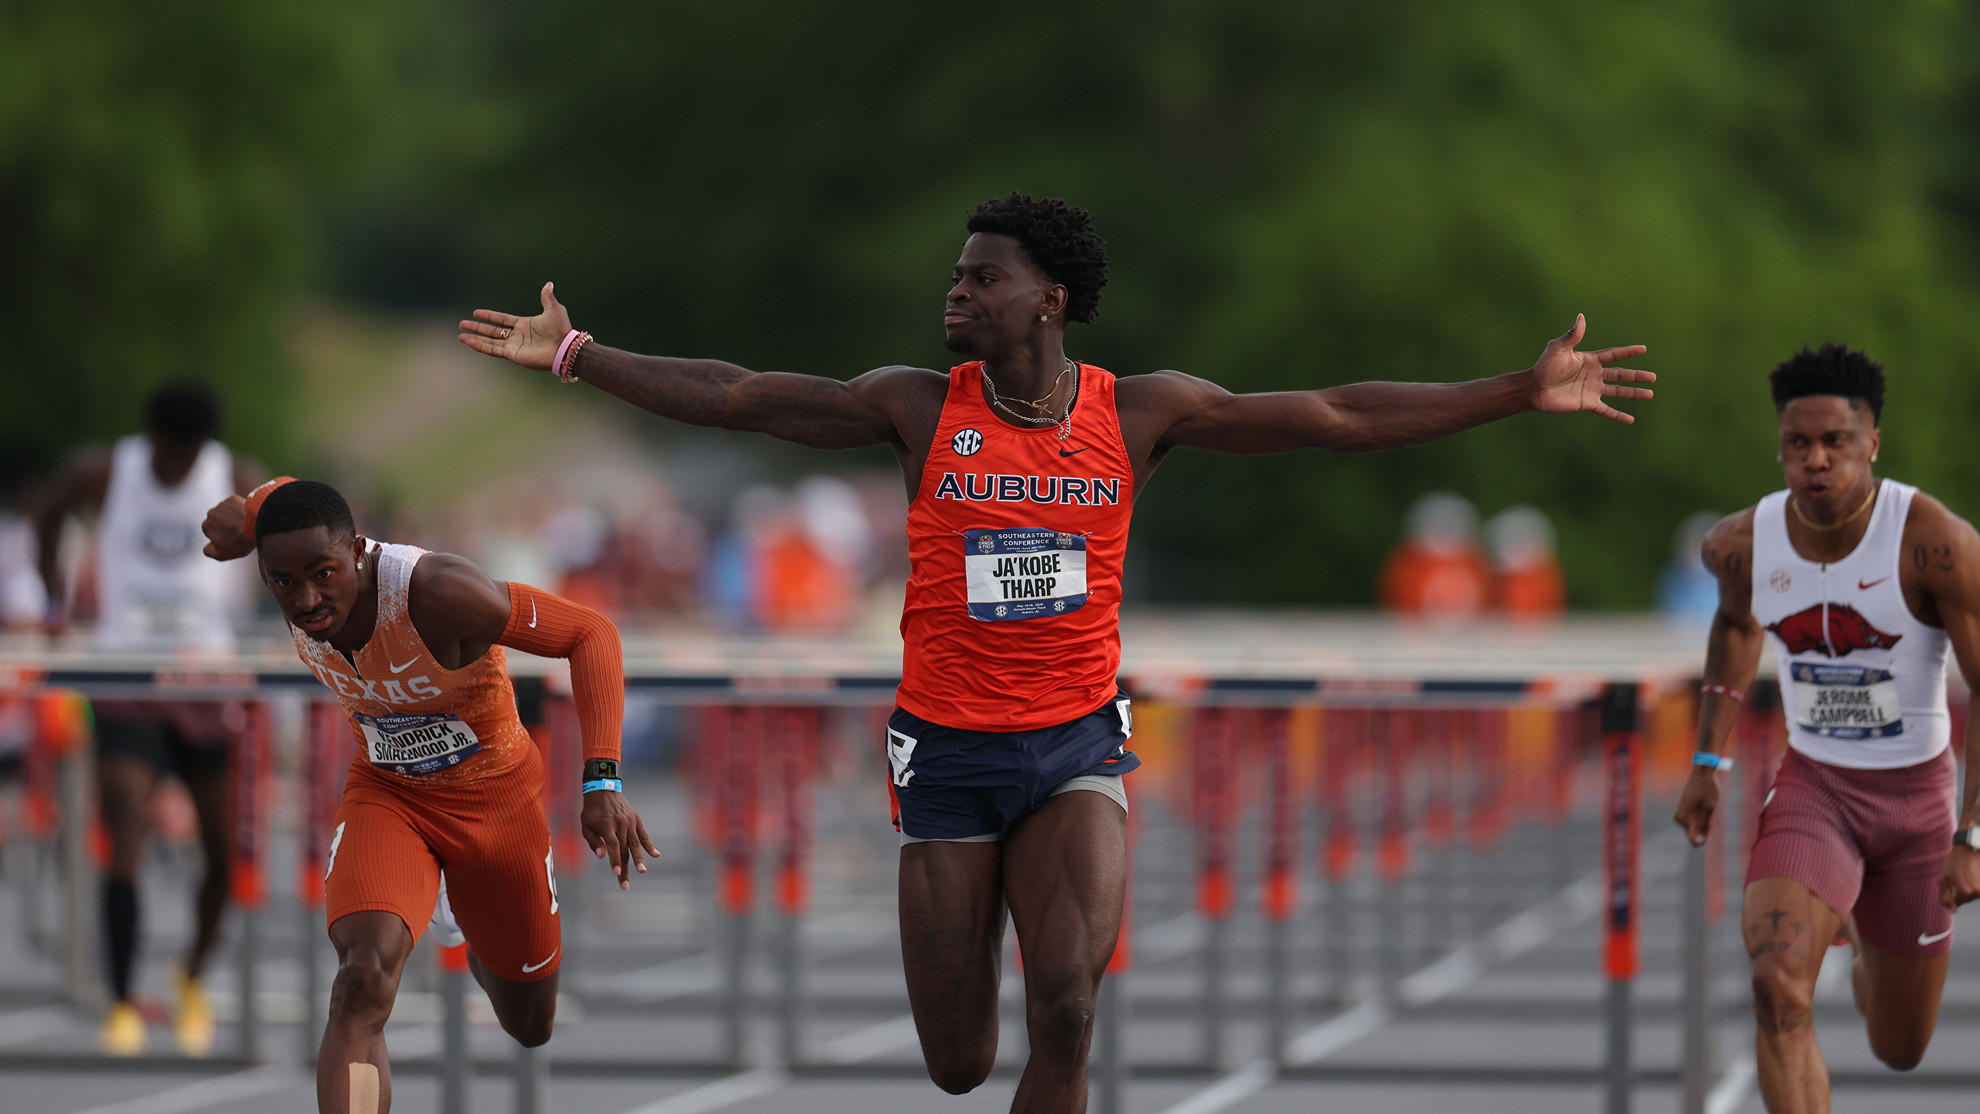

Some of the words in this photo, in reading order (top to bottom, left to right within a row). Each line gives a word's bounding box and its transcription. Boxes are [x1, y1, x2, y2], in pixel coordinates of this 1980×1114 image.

[952, 428, 983, 457] SEC
[935, 472, 1120, 506] AUBURN
[998, 532, 1055, 540] SOUTHEASTERN
[1003, 539, 1050, 547] CONFERENCE
[1000, 577, 1056, 599] THARP
[996, 605, 1008, 617] SEC
[1054, 600, 1066, 612] SEC
[307, 659, 442, 704] TEXAS
[1816, 689, 1873, 706] JEROME
[1809, 706, 1886, 725] CAMPBELL
[452, 732, 472, 748] JR.
